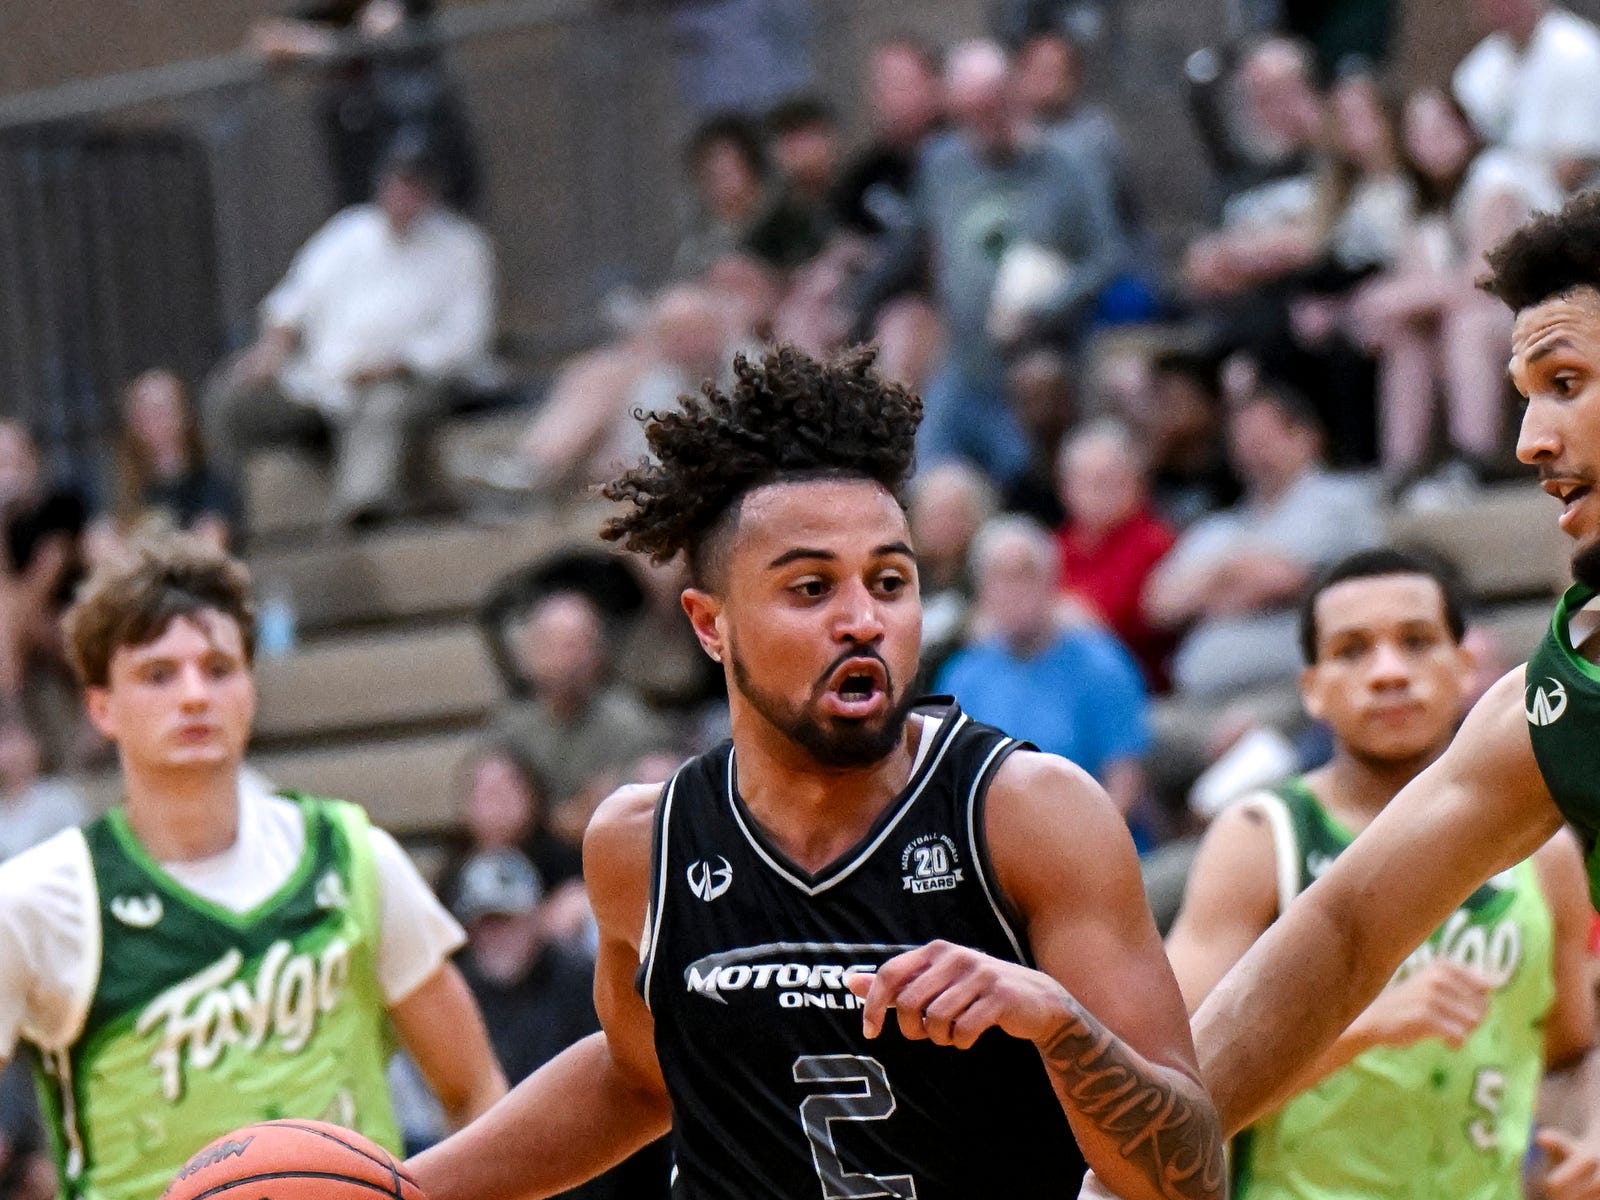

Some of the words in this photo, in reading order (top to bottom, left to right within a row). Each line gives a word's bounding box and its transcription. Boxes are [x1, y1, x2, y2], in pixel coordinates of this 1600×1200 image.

[914, 843, 949, 879] 20
[915, 877, 954, 891] YEARS
[792, 1054, 918, 1200] 2
[1468, 1068, 1506, 1150] 5
